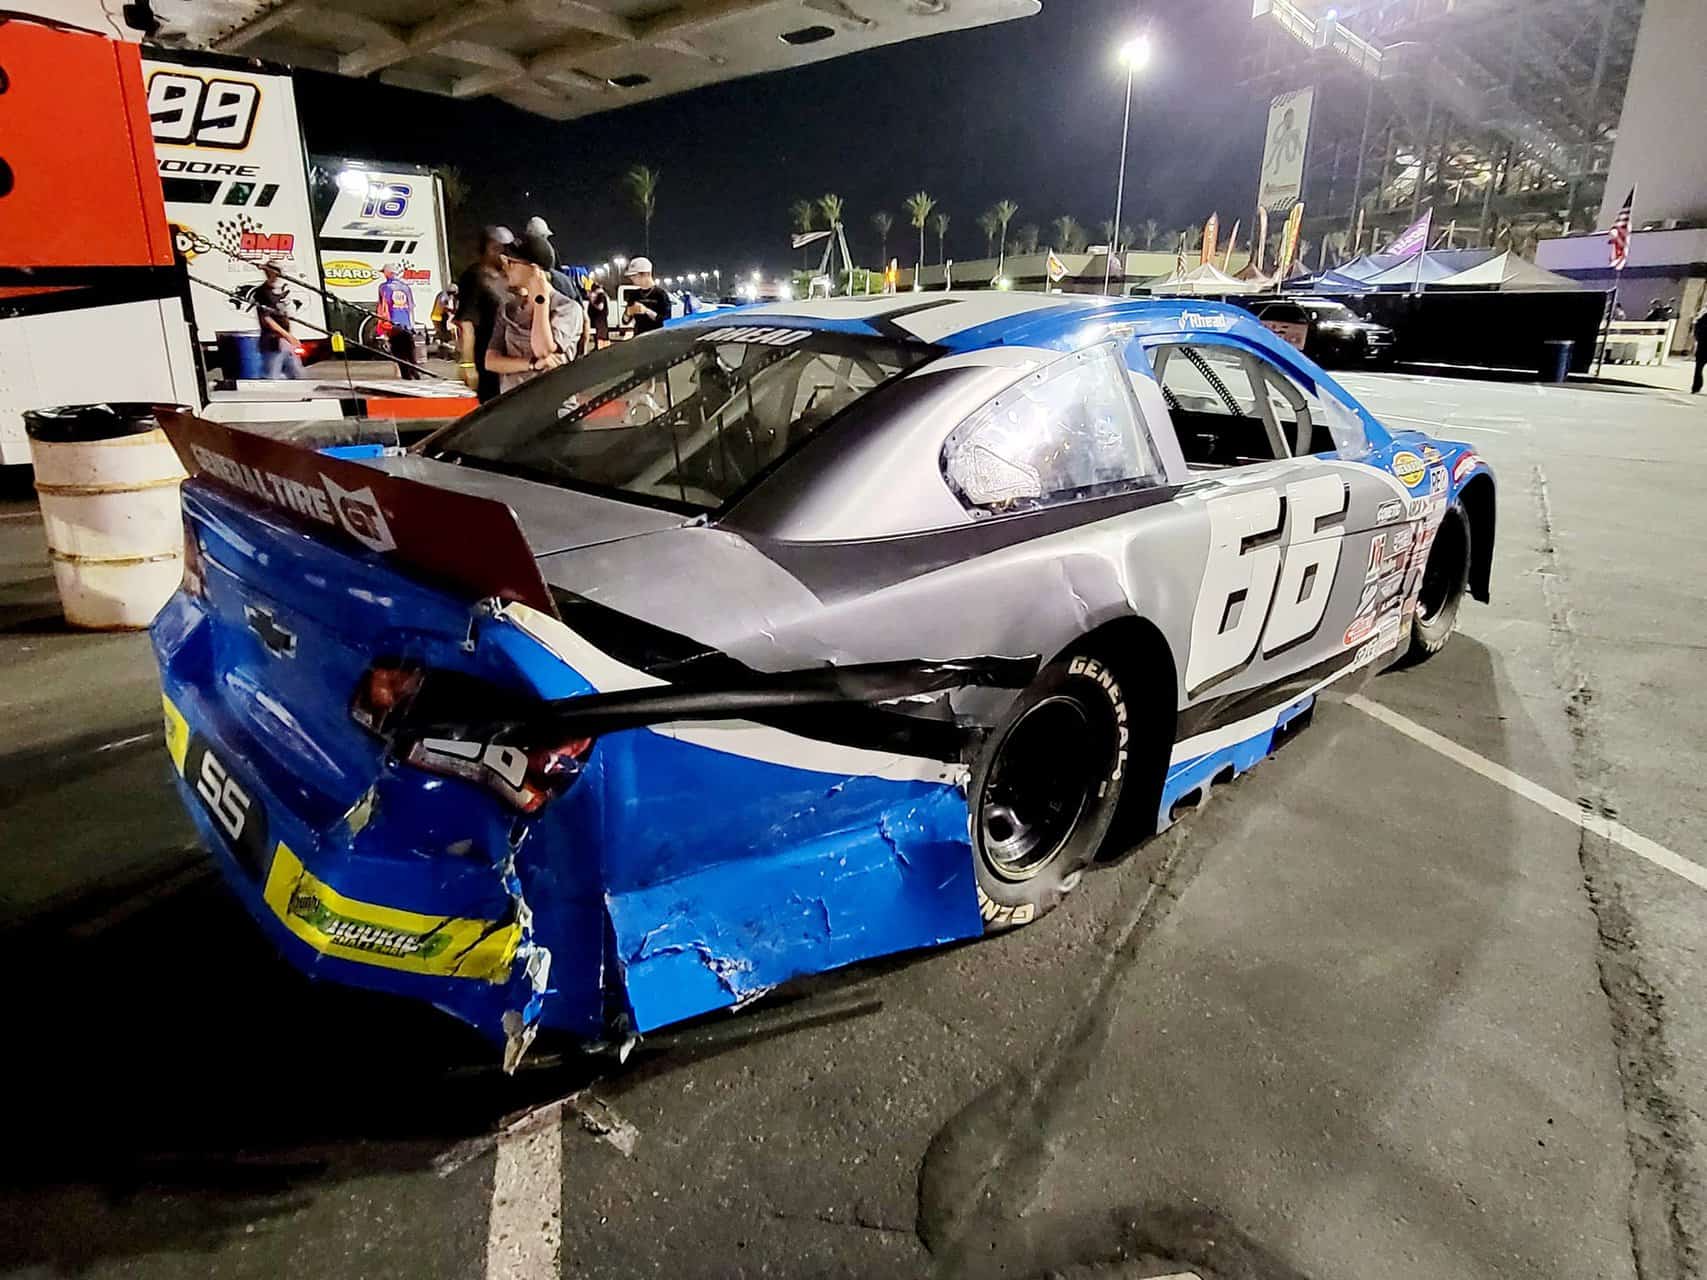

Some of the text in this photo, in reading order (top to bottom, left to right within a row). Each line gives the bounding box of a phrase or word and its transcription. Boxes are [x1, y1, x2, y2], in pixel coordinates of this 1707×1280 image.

[147, 71, 261, 150] 99
[157, 159, 261, 177] OORE
[361, 181, 413, 219] 16
[324, 268, 381, 281] ENARDS
[190, 442, 336, 526] GENERAL TIRE
[1185, 473, 1350, 701] 66
[1068, 655, 1129, 781] GENERAL
